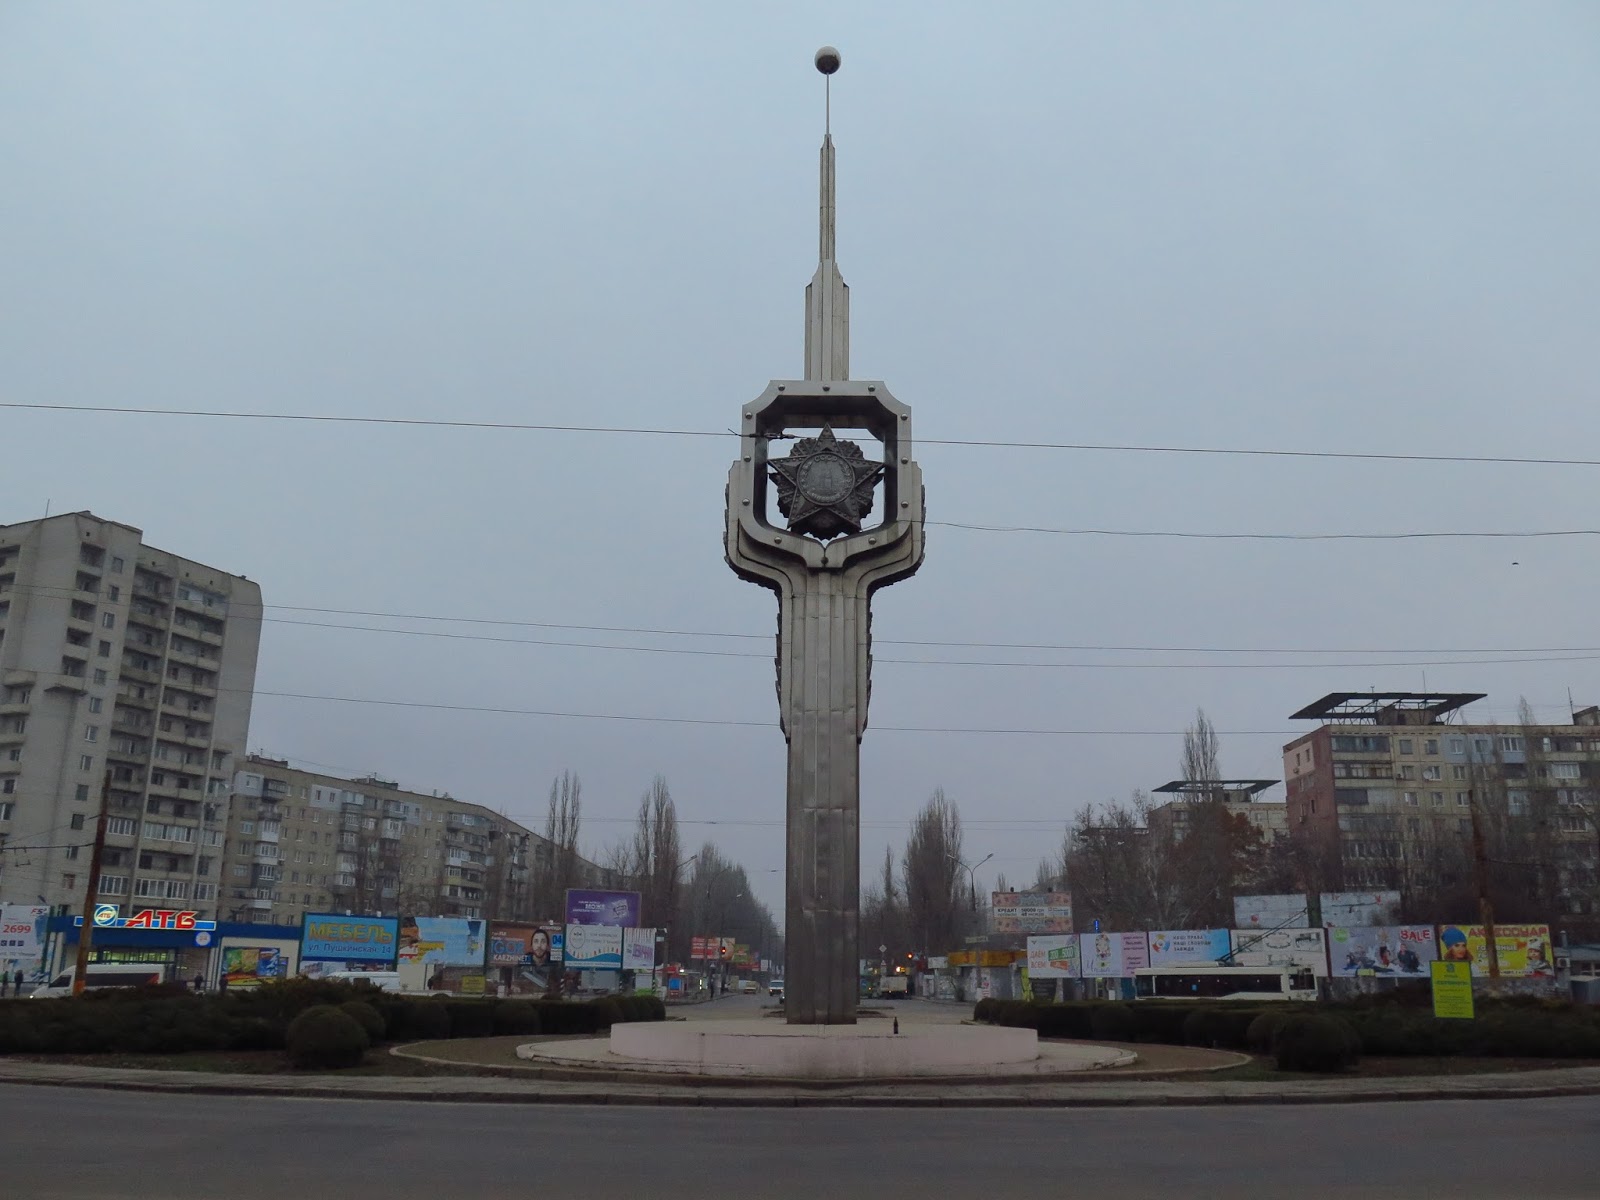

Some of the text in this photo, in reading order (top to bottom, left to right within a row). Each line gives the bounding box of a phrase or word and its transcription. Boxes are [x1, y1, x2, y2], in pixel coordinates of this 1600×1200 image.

[124, 909, 198, 930] АТБ
[3, 924, 31, 934] 2699
[308, 921, 393, 944] МЕБЕЛЬ
[1468, 927, 1548, 938] АКЕССУАР
[1401, 929, 1431, 943] SALE
[324, 943, 377, 953] Пушкинская
